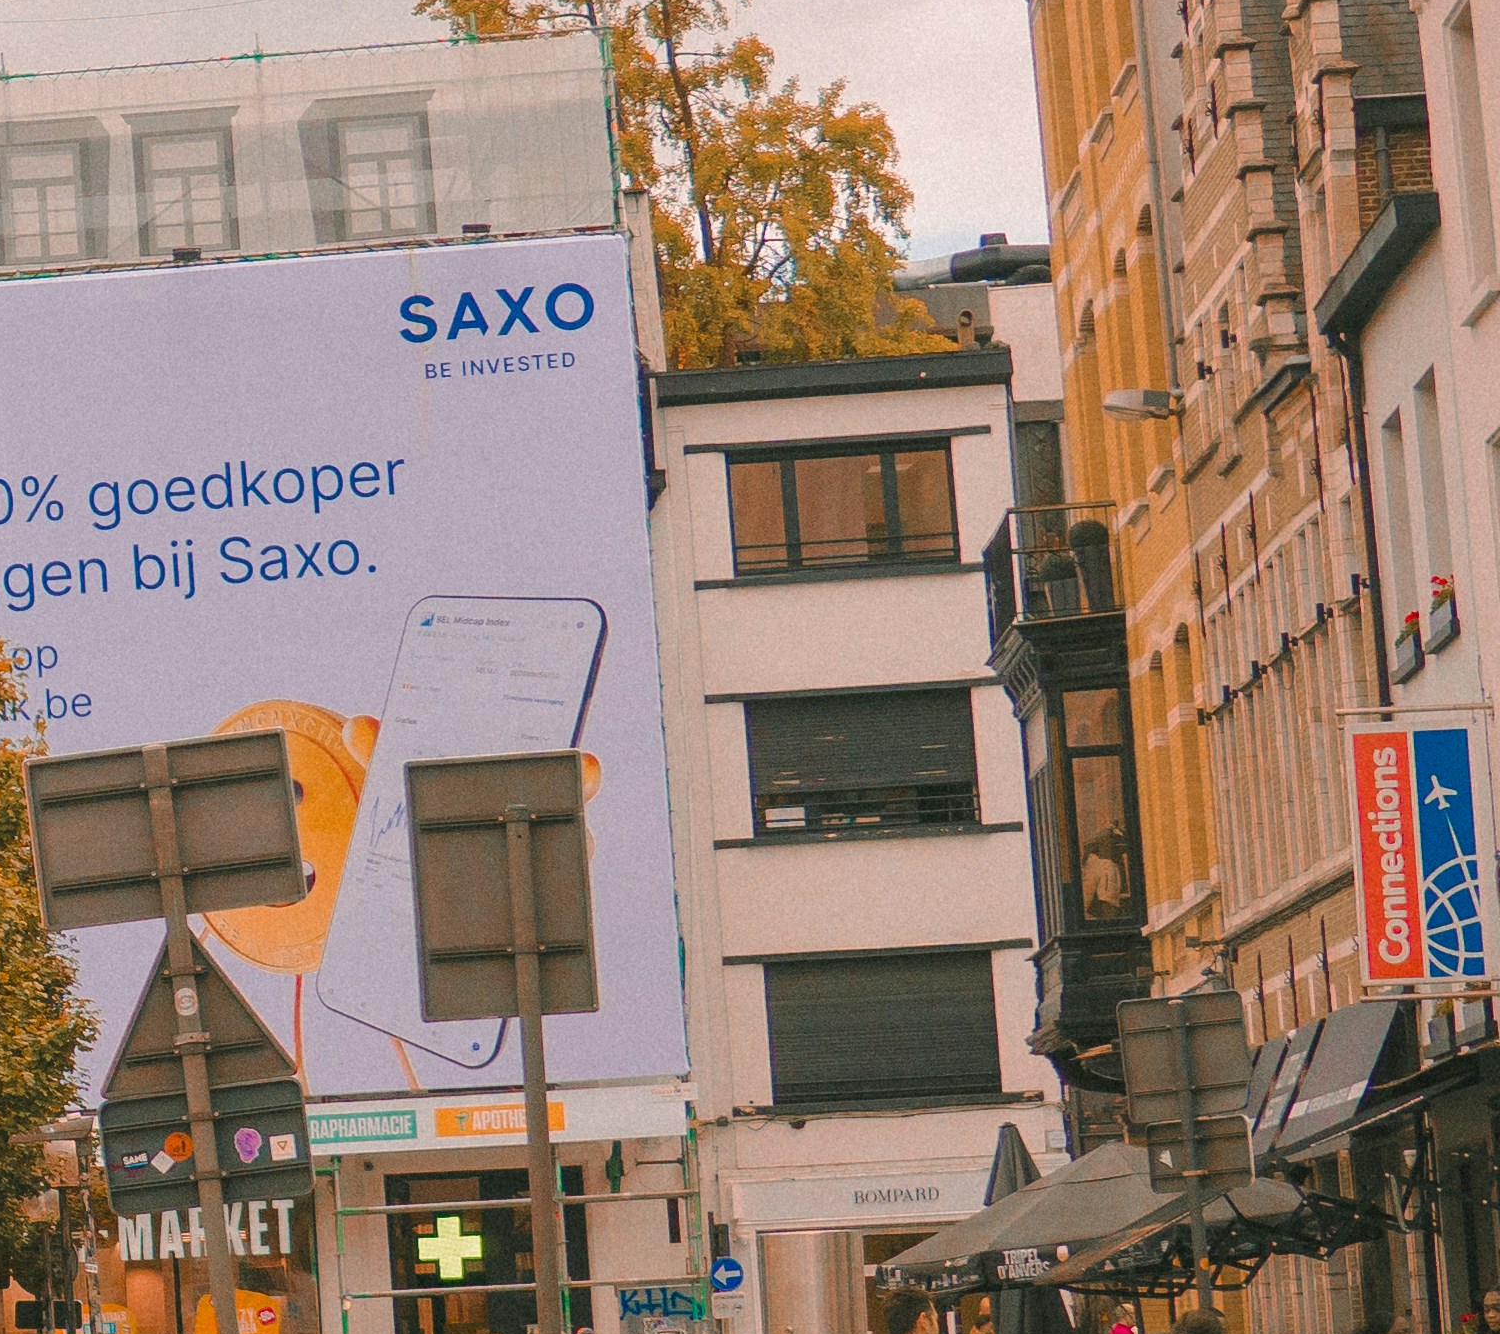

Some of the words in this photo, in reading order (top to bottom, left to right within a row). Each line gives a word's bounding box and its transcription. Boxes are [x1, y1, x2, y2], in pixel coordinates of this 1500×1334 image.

[399, 282, 595, 344] SAXO
[424, 362, 452, 380] BE
[461, 351, 576, 377] INVESTED
[88, 458, 405, 531] goedkoper
[132, 540, 197, 600] bij
[219, 535, 378, 585] Saxo.
[11, 643, 59, 678] op
[1367, 746, 1411, 964] Connections
[309, 1113, 414, 1140] RAPHARMACIE
[472, 1110, 527, 1133] APOTHE
[853, 1186, 940, 1205] BOMPARD
[1002, 1247, 1040, 1265] TRIPEL
